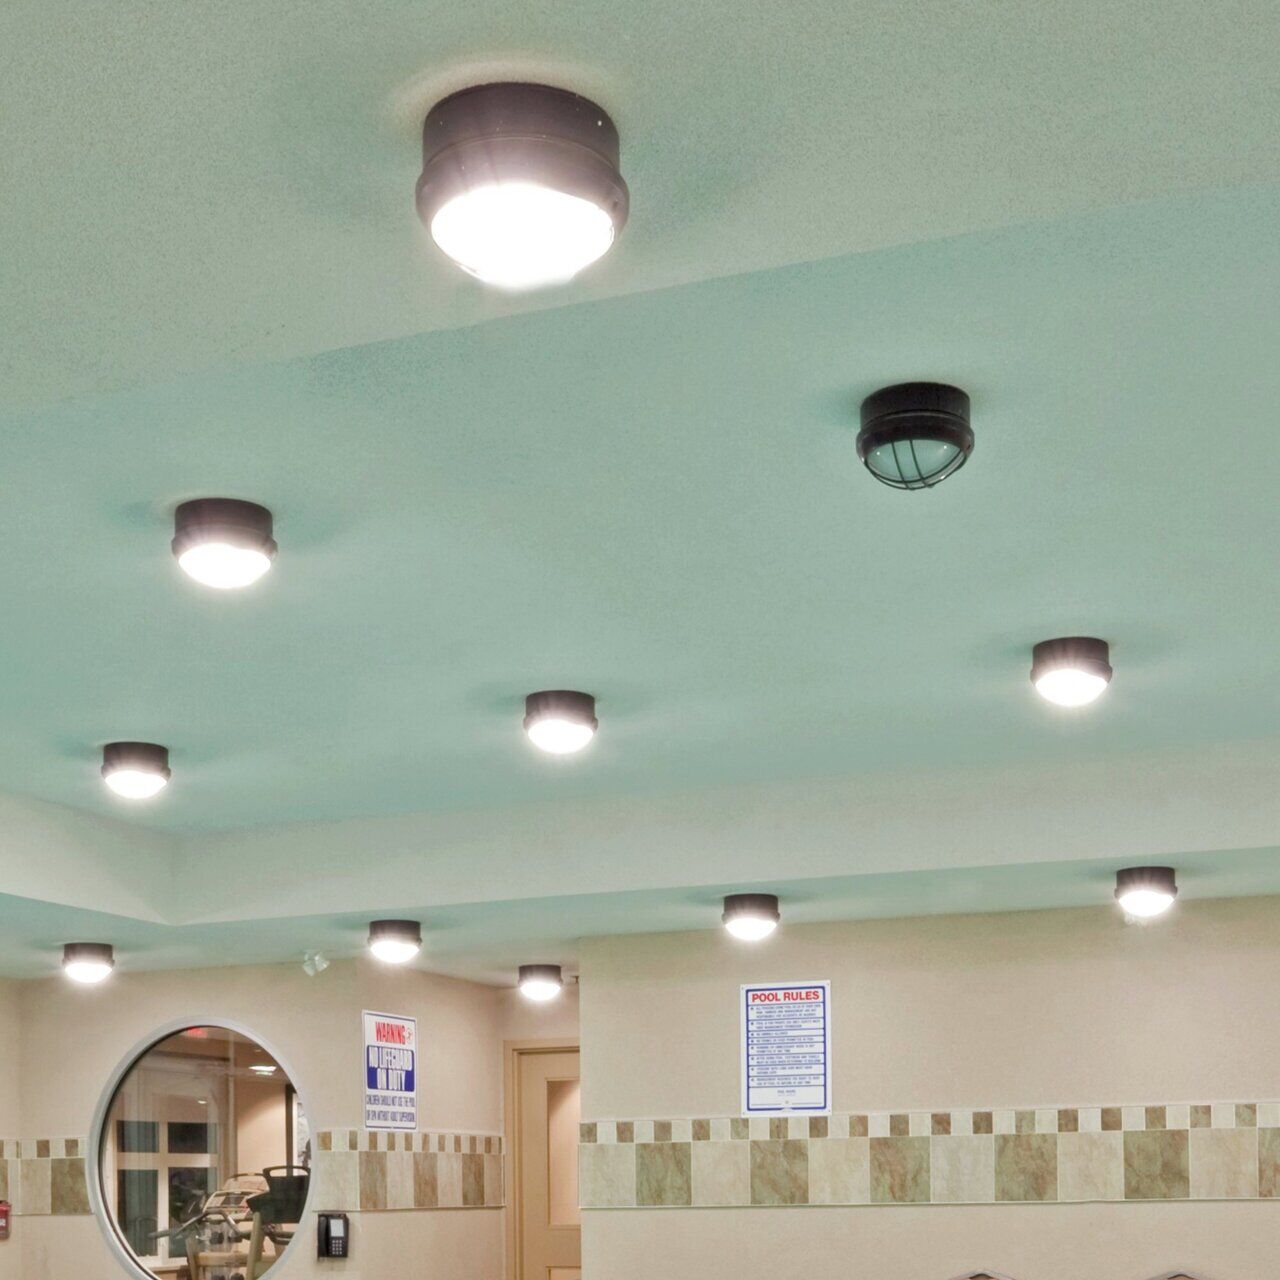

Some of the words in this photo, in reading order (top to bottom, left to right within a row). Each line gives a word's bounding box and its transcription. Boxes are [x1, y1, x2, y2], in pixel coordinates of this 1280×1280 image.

[752, 993, 780, 1002] POOL
[783, 991, 820, 1001] RULES
[375, 1021, 406, 1045] WARNING
[379, 1047, 412, 1071] LIFEGUARD
[388, 1069, 406, 1091] DUTY
